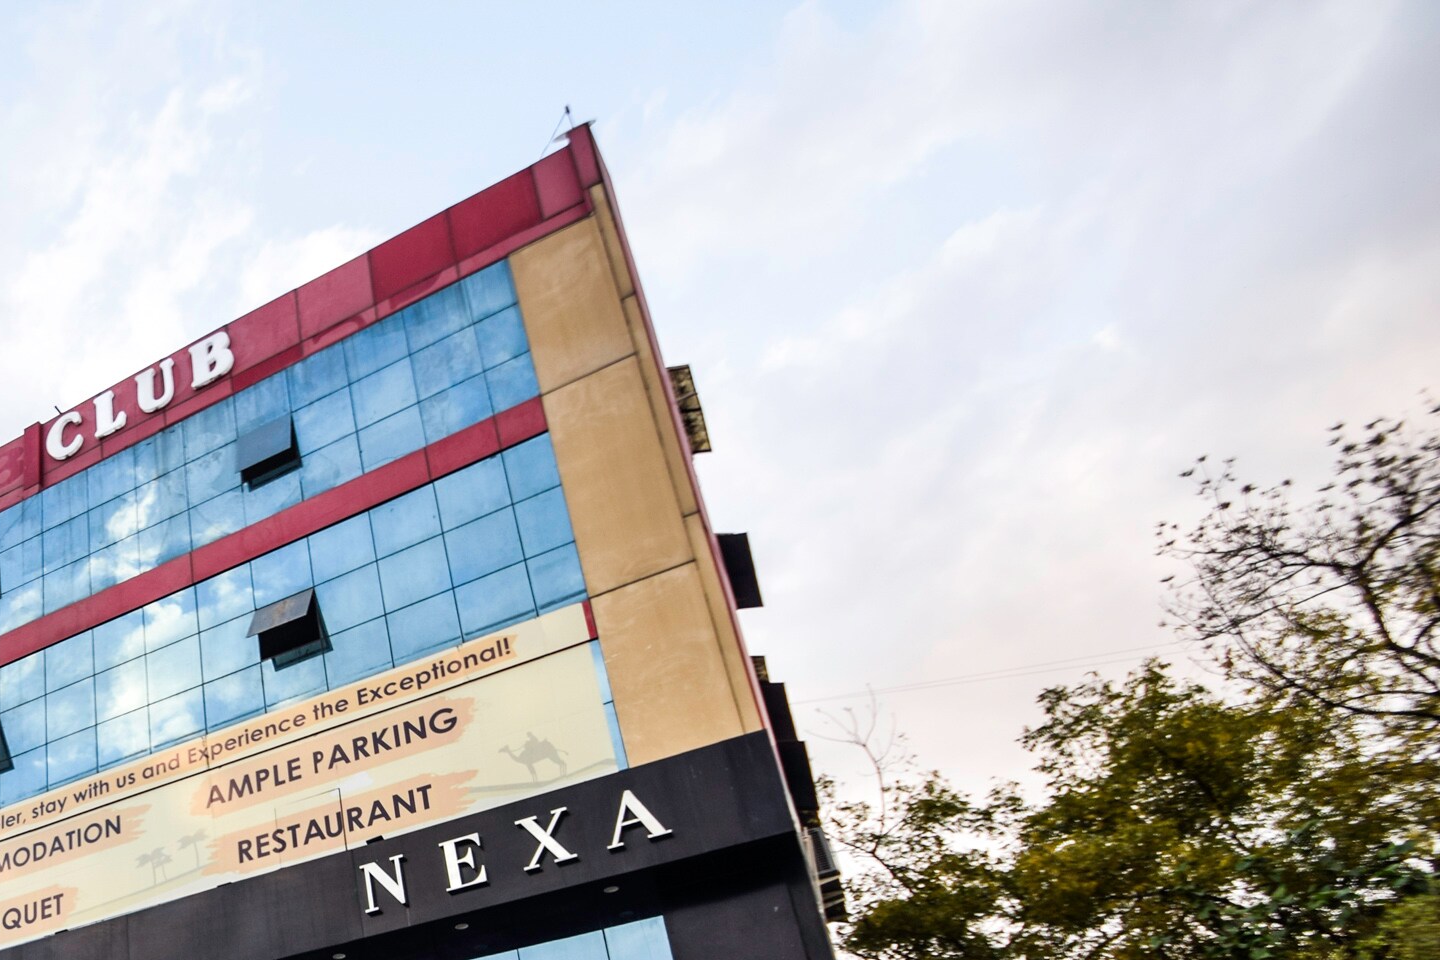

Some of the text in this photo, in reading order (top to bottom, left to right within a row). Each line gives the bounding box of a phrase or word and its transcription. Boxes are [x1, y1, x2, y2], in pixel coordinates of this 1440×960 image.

[46, 331, 235, 460] CLUB
[31, 796, 67, 820] stay
[73, 779, 110, 804] with
[116, 772, 135, 789] us
[142, 752, 181, 780] and
[188, 710, 306, 765] Experience
[312, 696, 349, 722] the
[357, 637, 512, 706] Exceptional!
[206, 707, 458, 809] AMPLE PARKING
[237, 784, 434, 864] RESTAURANT
[360, 789, 672, 915] NEXA
